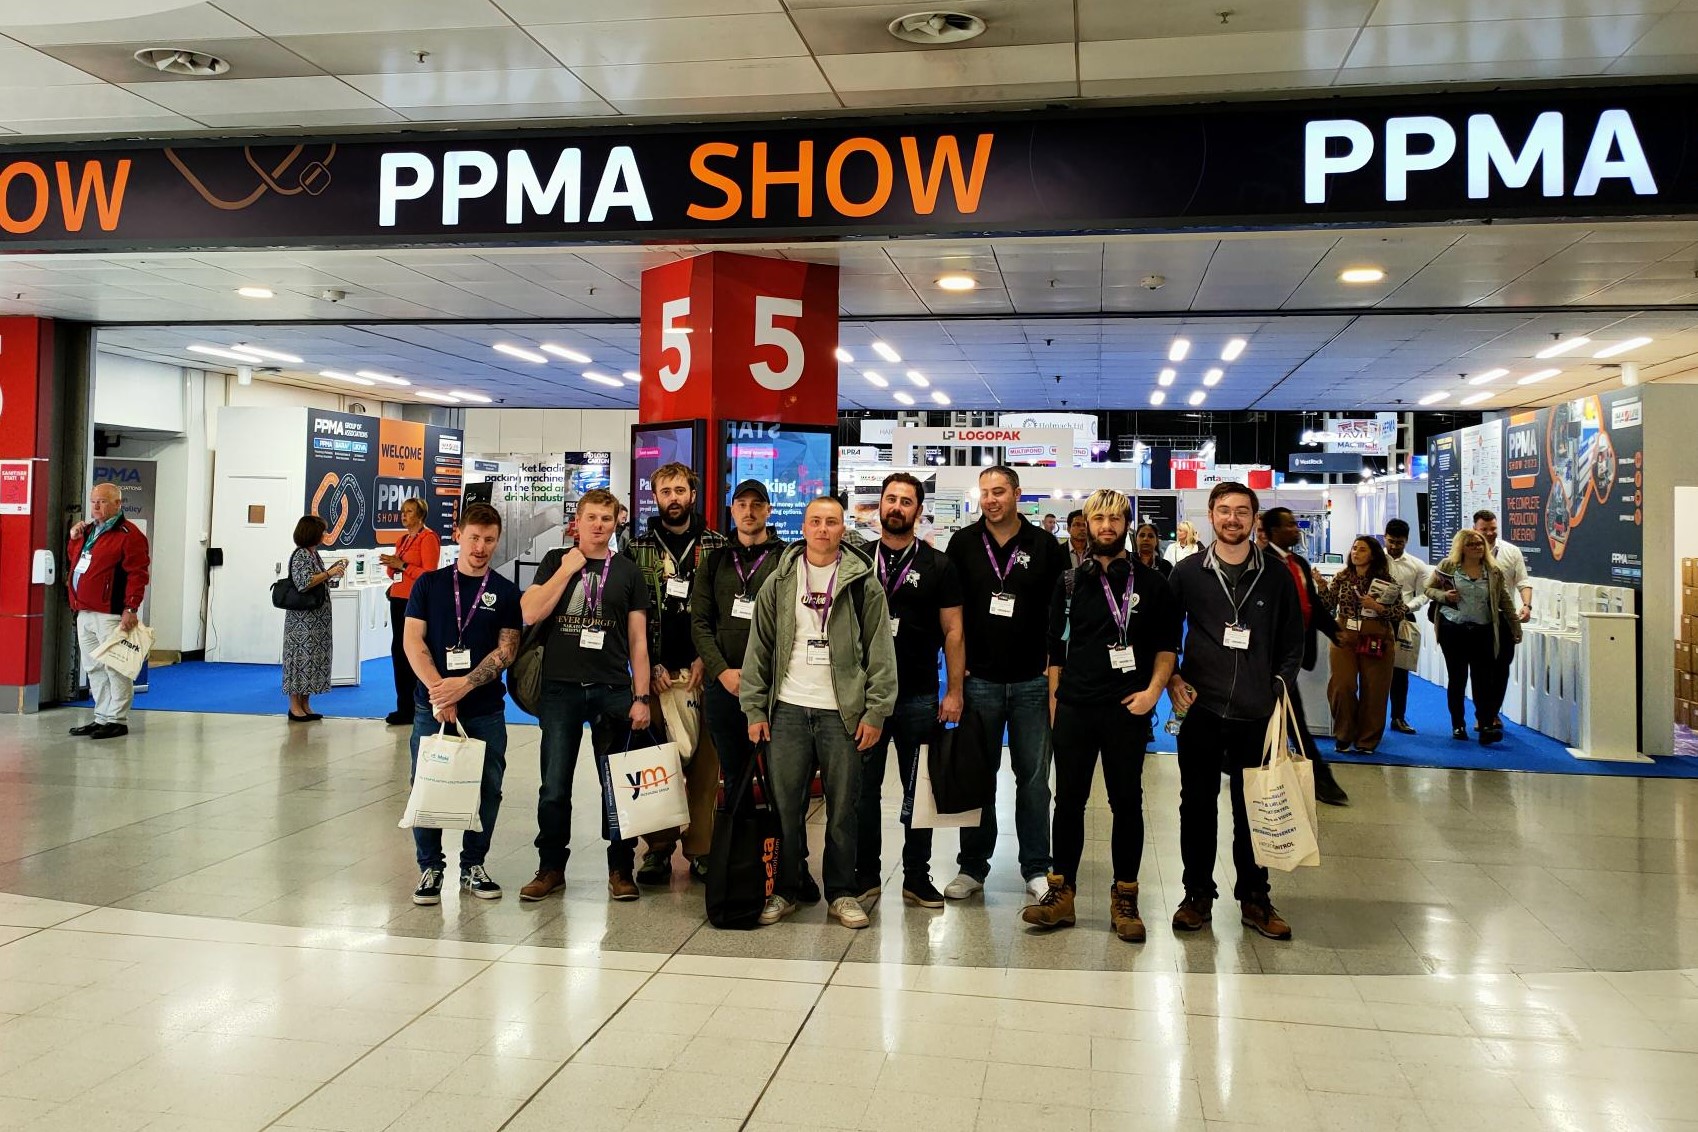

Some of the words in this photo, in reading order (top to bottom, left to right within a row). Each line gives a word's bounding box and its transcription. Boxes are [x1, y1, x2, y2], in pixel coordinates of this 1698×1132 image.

[1304, 109, 1659, 204] PPMA
[378, 145, 654, 227] PPMA
[686, 133, 994, 221] SHOW
[658, 296, 694, 393] 5
[749, 295, 805, 391] 5
[314, 418, 344, 435] PPMA
[958, 431, 1021, 440] LOGOPAK
[1509, 429, 1537, 458] PPMA
[381, 444, 422, 460] WELCOME
[398, 462, 405, 471] TO
[485, 474, 521, 483] packing
[503, 483, 512, 492] in
[515, 483, 529, 492] the
[531, 481, 552, 492] food
[505, 492, 529, 502] drink
[376, 512, 399, 523] SHOW
[625, 766, 669, 800] ym
